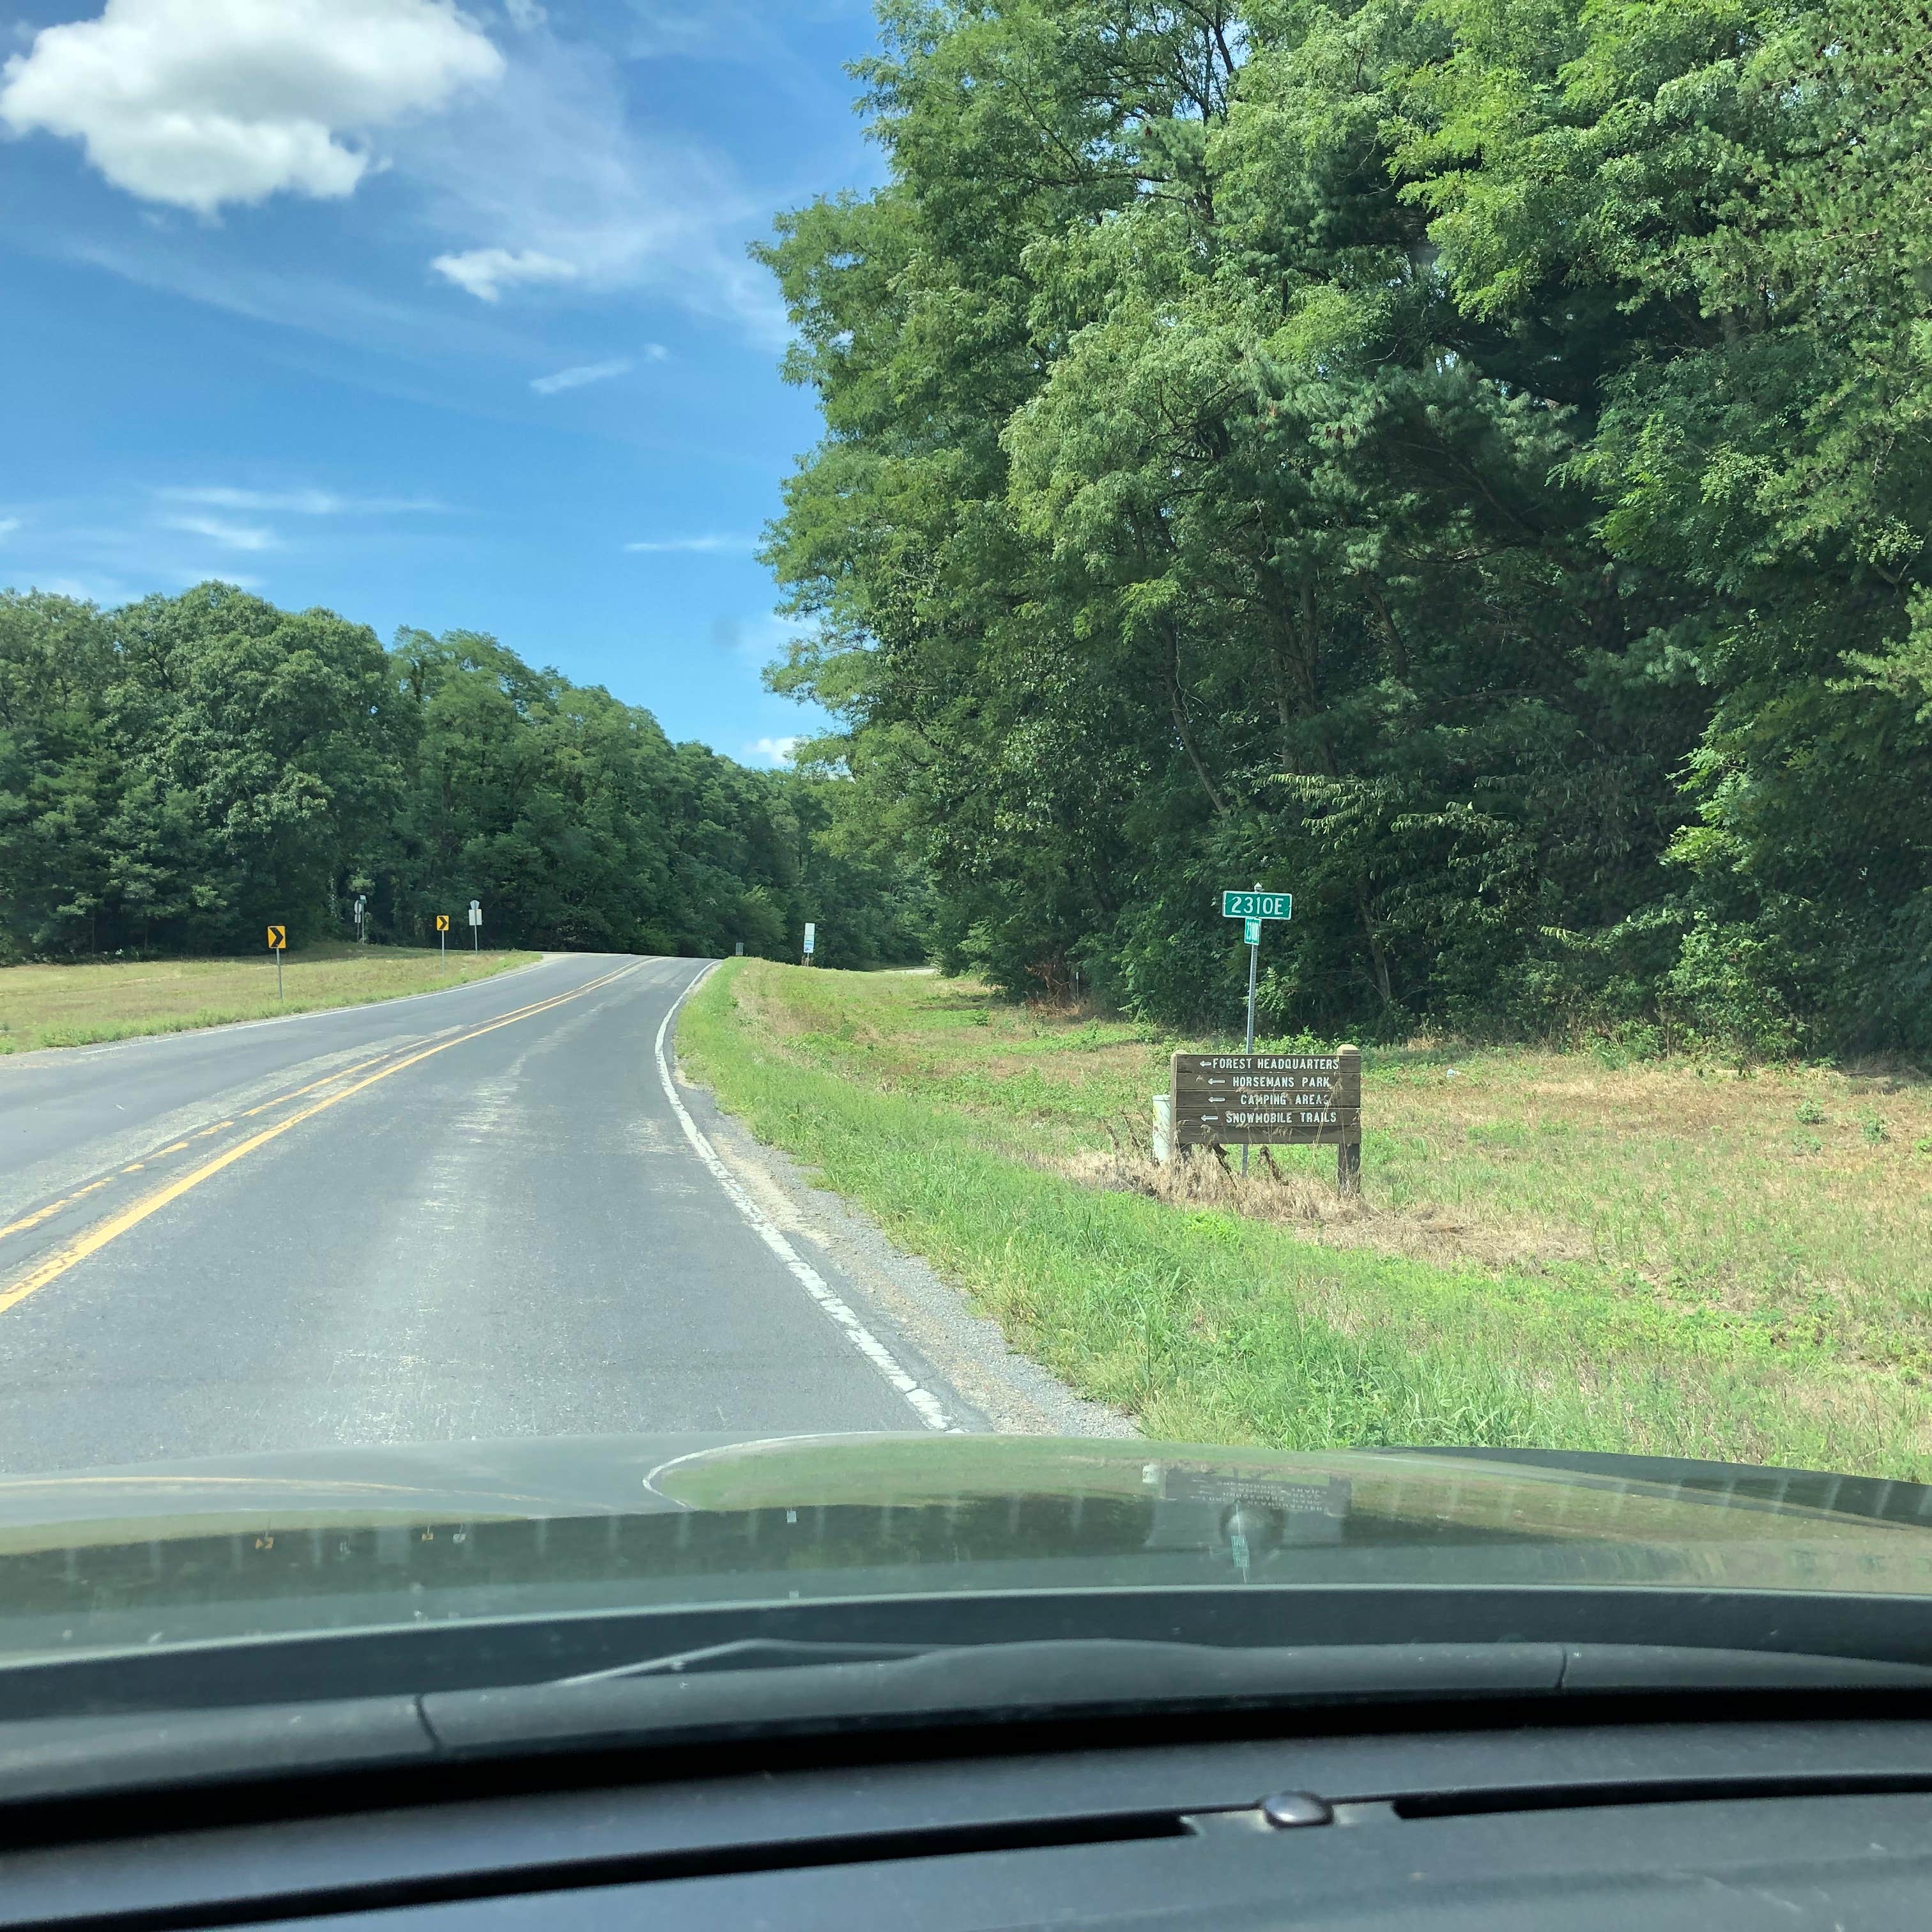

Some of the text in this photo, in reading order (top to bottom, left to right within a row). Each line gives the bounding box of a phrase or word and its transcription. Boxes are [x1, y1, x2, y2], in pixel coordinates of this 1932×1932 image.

[1231, 896, 1284, 915] 2310E
[1213, 1058, 1339, 1070] FOREST HEADQUARTERS
[1232, 1077, 1330, 1087] HORSEMANS PARK
[1240, 1094, 1330, 1105] CAMPING AREAS
[1225, 1111, 1337, 1123] SNOWMOBILE TRAILS
